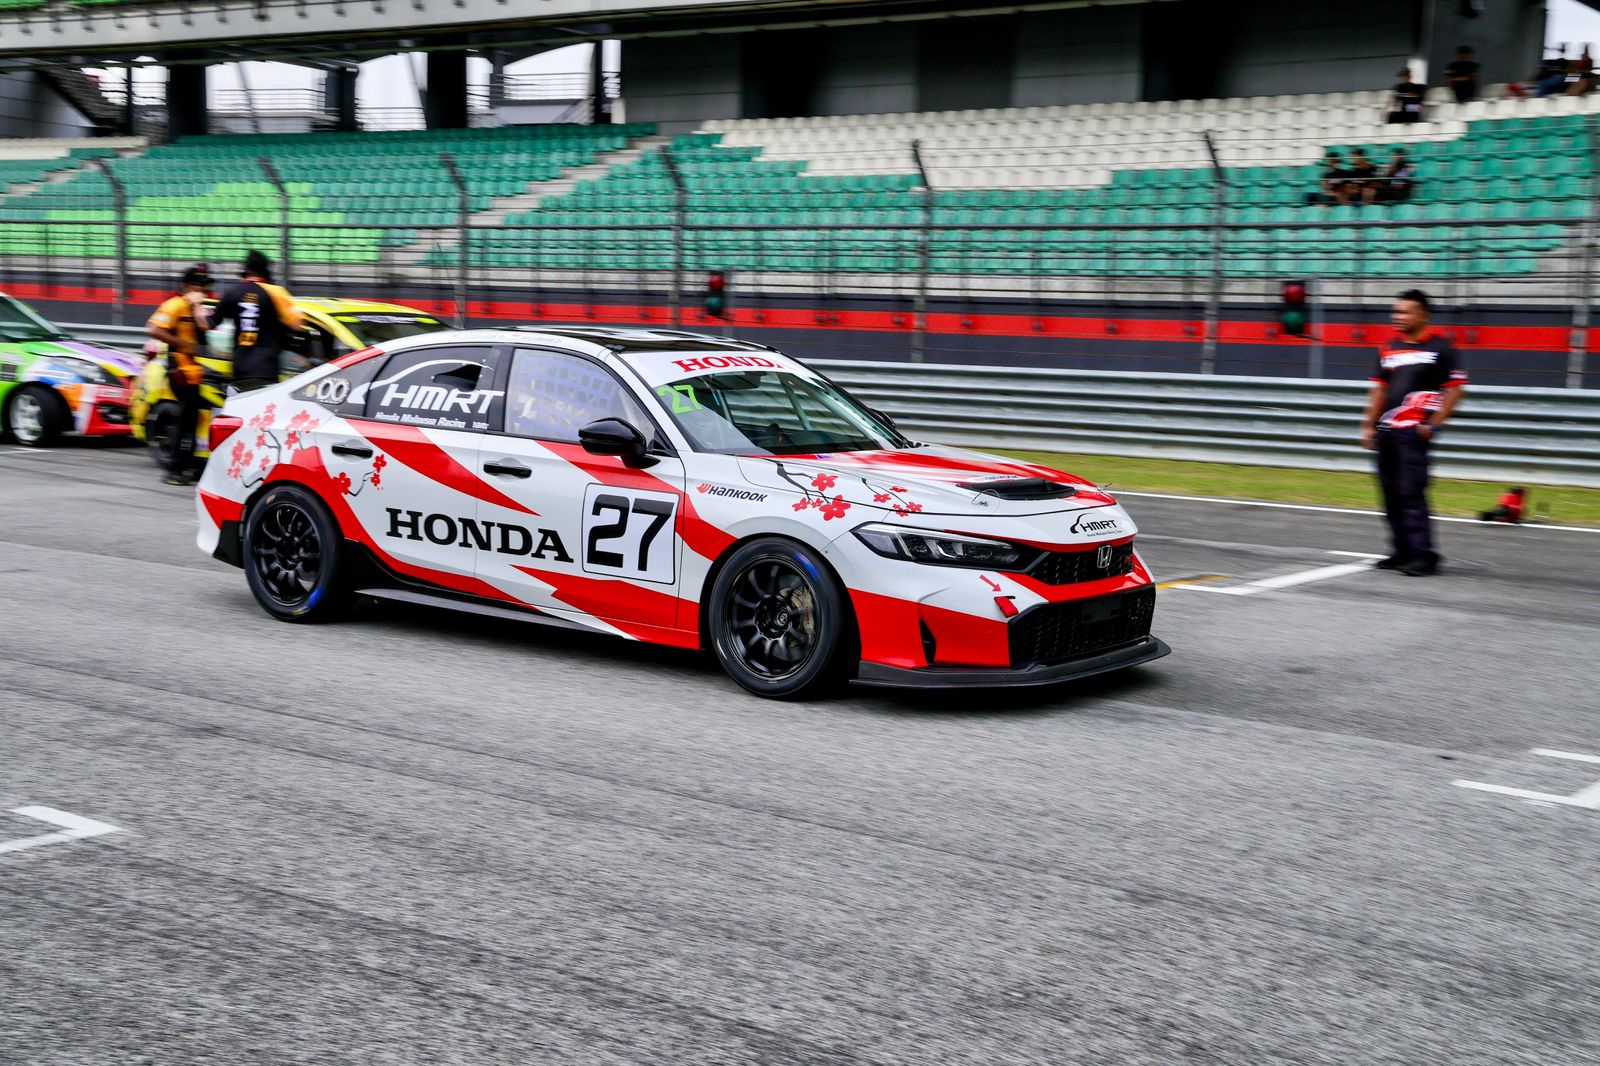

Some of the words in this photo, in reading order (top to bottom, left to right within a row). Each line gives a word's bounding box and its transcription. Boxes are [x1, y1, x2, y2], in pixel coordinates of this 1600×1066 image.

[380, 383, 505, 413] HMRT
[657, 384, 703, 414] 27
[385, 507, 574, 563] HONDA
[586, 493, 675, 572] 27
[1080, 519, 1117, 532] HMRT
